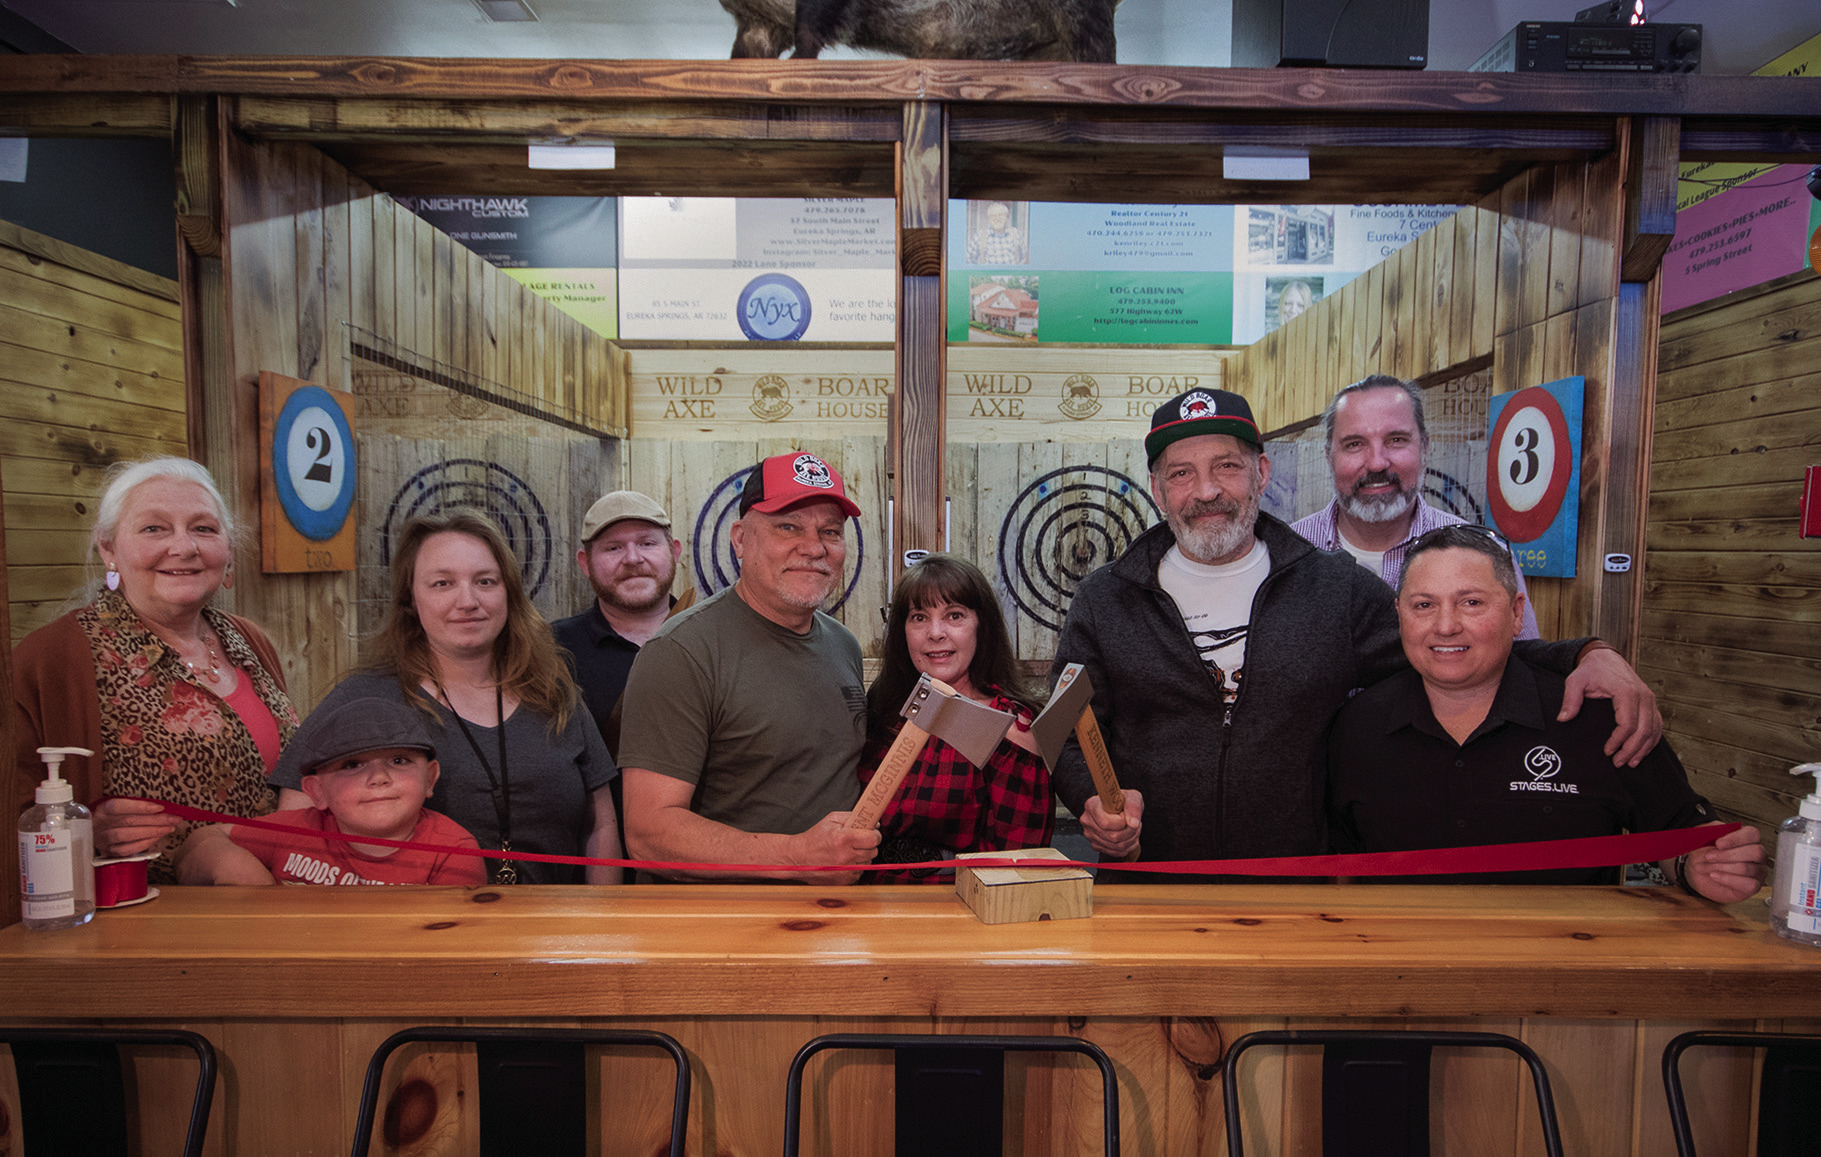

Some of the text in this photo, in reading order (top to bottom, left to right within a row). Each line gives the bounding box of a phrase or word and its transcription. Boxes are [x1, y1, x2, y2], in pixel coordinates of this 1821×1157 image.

[1691, 185, 1719, 205] League
[1722, 167, 1758, 190] Sponsor
[420, 198, 529, 211] NIGHTHAWK
[472, 209, 529, 218] CUSTOM
[1144, 210, 1177, 218] Century
[1350, 209, 1371, 218] Fine
[1374, 209, 1405, 218] Foods
[1407, 210, 1415, 218] &
[803, 216, 829, 225] South
[831, 216, 851, 224] Main
[1400, 219, 1406, 229] 7
[470, 232, 517, 240] GUNSMITH
[793, 227, 825, 235] Eureka
[864, 227, 875, 235] AR
[1367, 232, 1407, 242] Eureka
[755, 260, 777, 268] Lane
[779, 260, 816, 270] Sponsor
[1692, 256, 1721, 274] Spring
[1724, 244, 1753, 261] Street
[1110, 286, 1130, 294] LOG
[1132, 286, 1164, 294] CABIN
[564, 295, 606, 304] Manager
[829, 299, 845, 308] We
[848, 300, 864, 308] are
[867, 299, 883, 308] the
[626, 311, 655, 320] EUREKA
[747, 297, 800, 325] Nyx
[830, 312, 867, 321] favorite
[1127, 308, 1162, 316] Highway
[656, 376, 723, 396] WILD
[817, 377, 890, 396] BOAR
[963, 374, 1032, 395] WILD
[663, 399, 716, 418] AXE
[817, 401, 888, 418] HOUSE
[969, 398, 1025, 417] AXE
[304, 426, 333, 484] 2
[1510, 427, 1539, 485] 3
[304, 548, 333, 569] two
[867, 736, 916, 807] MCGINNIS
[1509, 781, 1580, 794] STAGES.LIVE
[34, 834, 55, 845] 75%
[282, 852, 341, 885] MOODS
[1806, 856, 1820, 907] HAND SANITIZER
